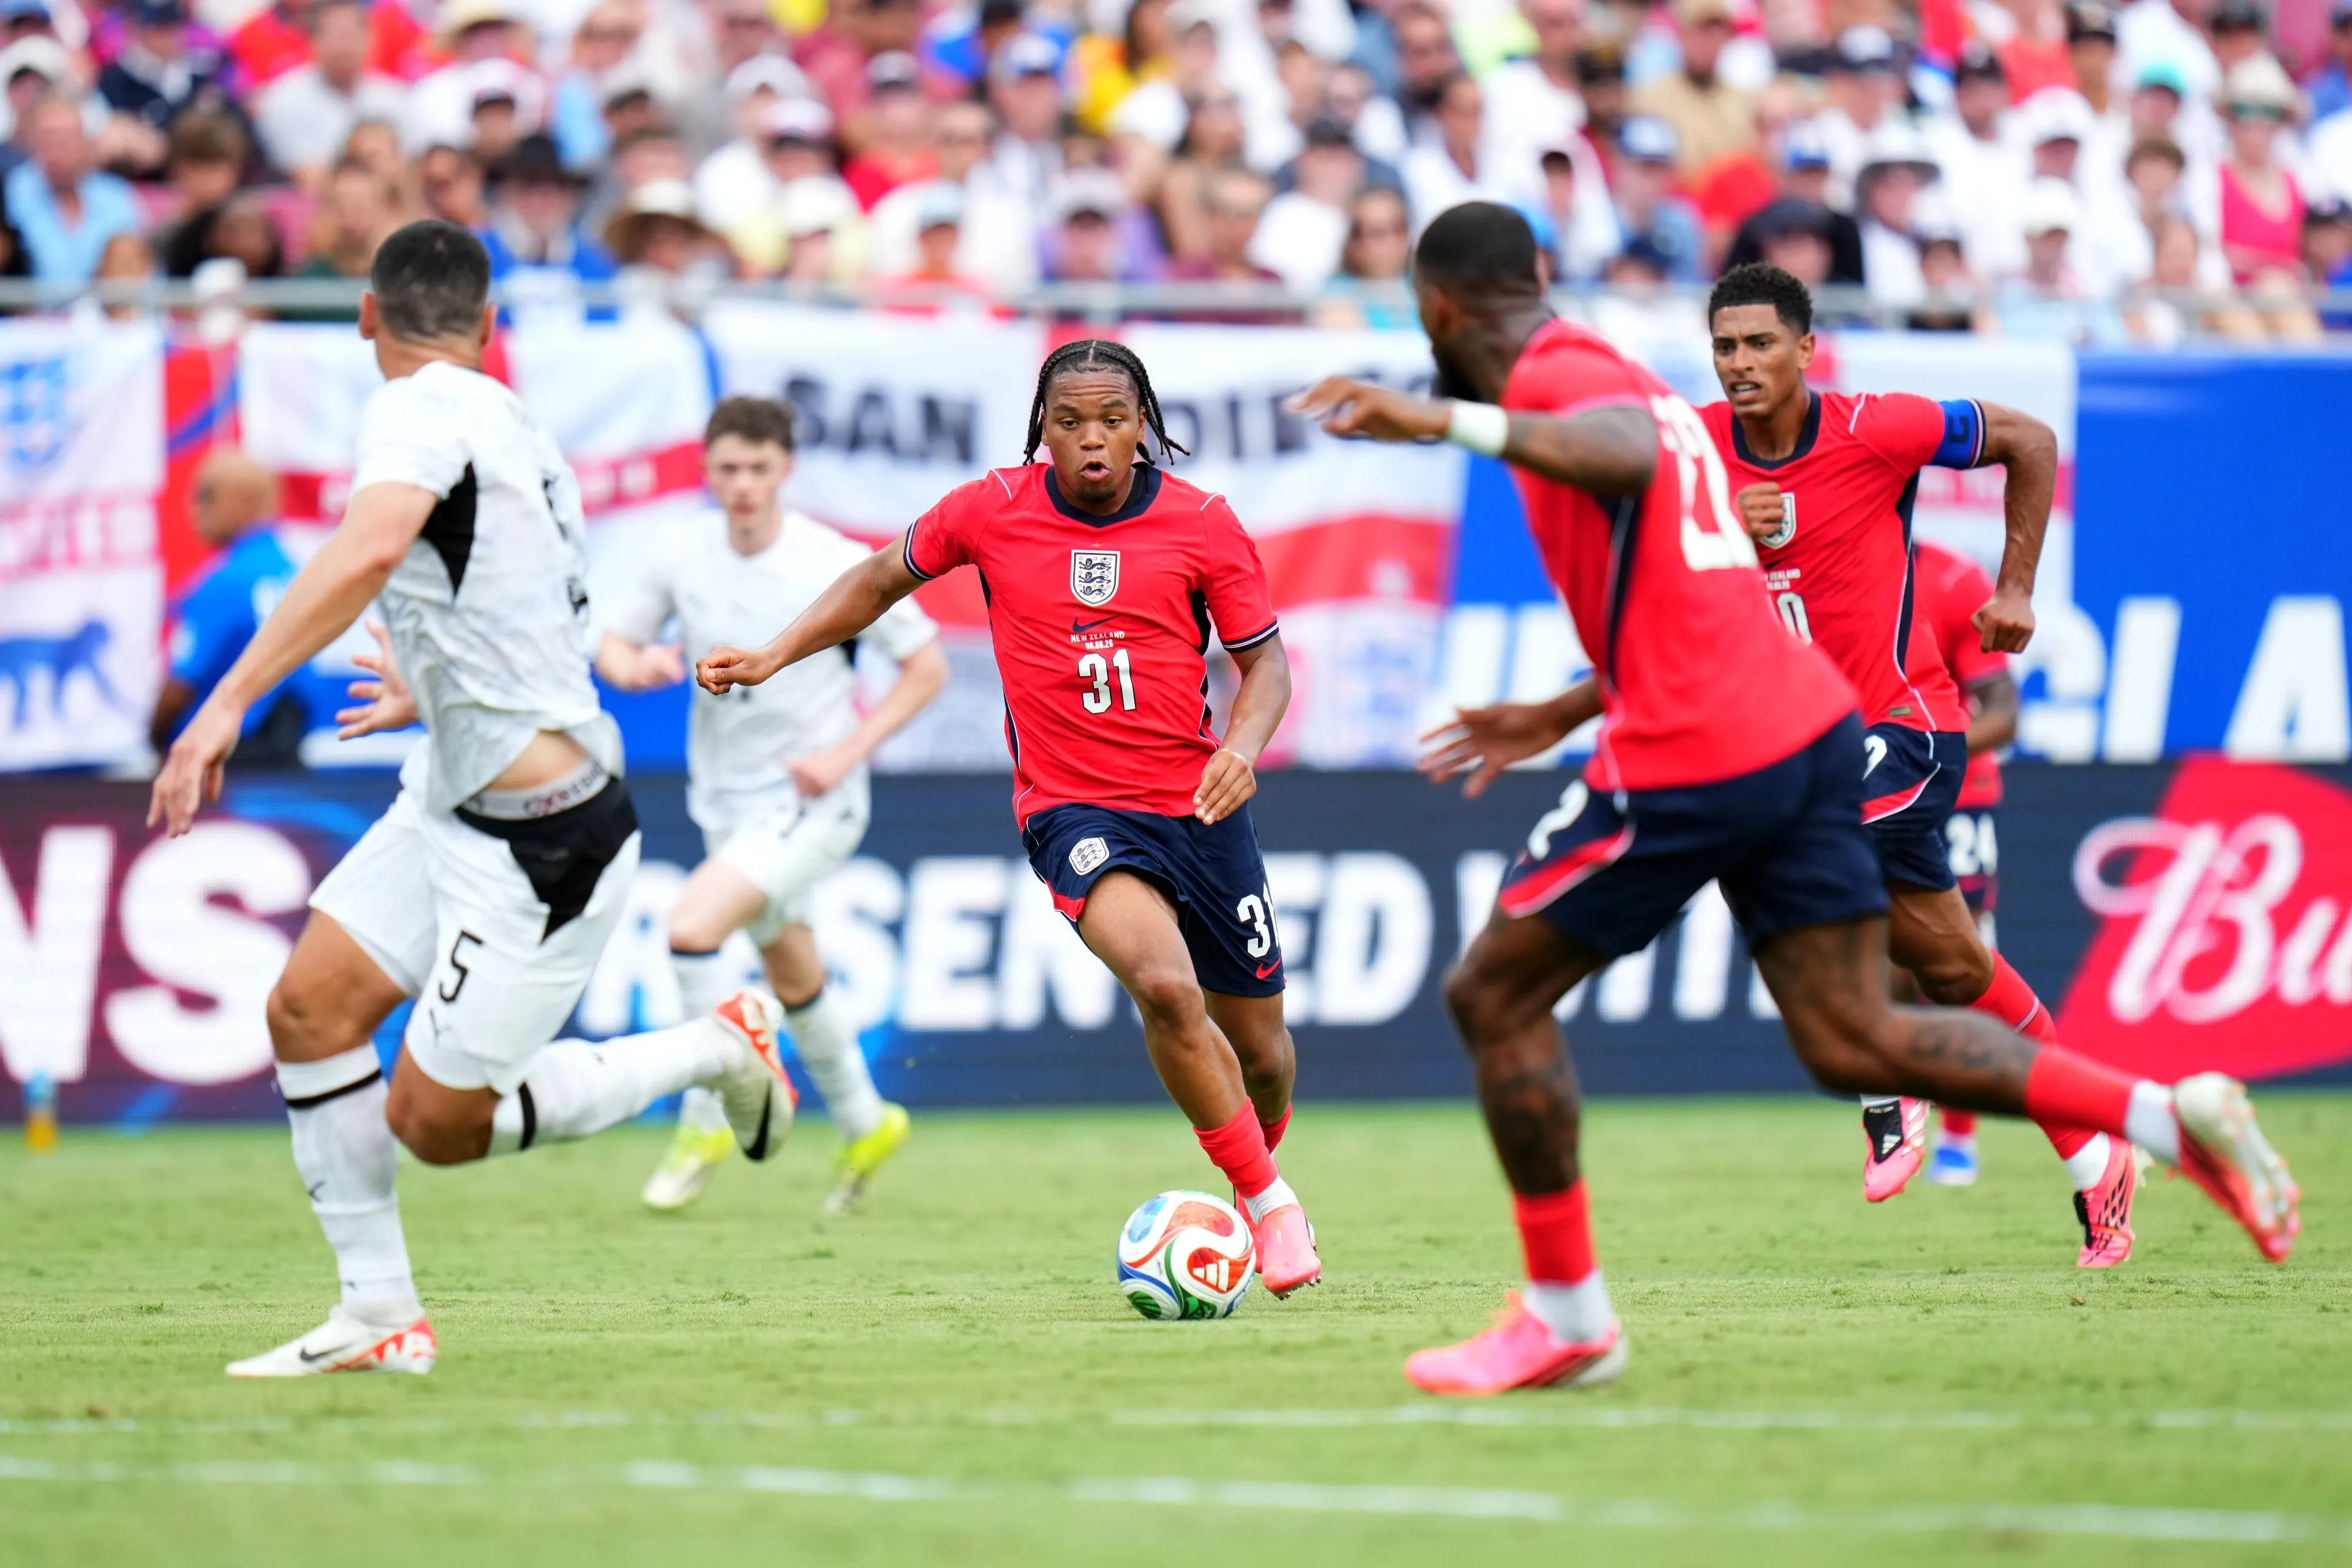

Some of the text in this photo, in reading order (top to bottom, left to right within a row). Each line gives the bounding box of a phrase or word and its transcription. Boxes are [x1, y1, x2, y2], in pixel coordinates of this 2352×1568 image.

[1071, 631, 1125, 643] NEW ZEALAND
[1766, 592, 1813, 647] 0
[1078, 649, 1136, 714] 31
[1237, 883, 1279, 958] 31
[439, 930, 484, 1003] 5
